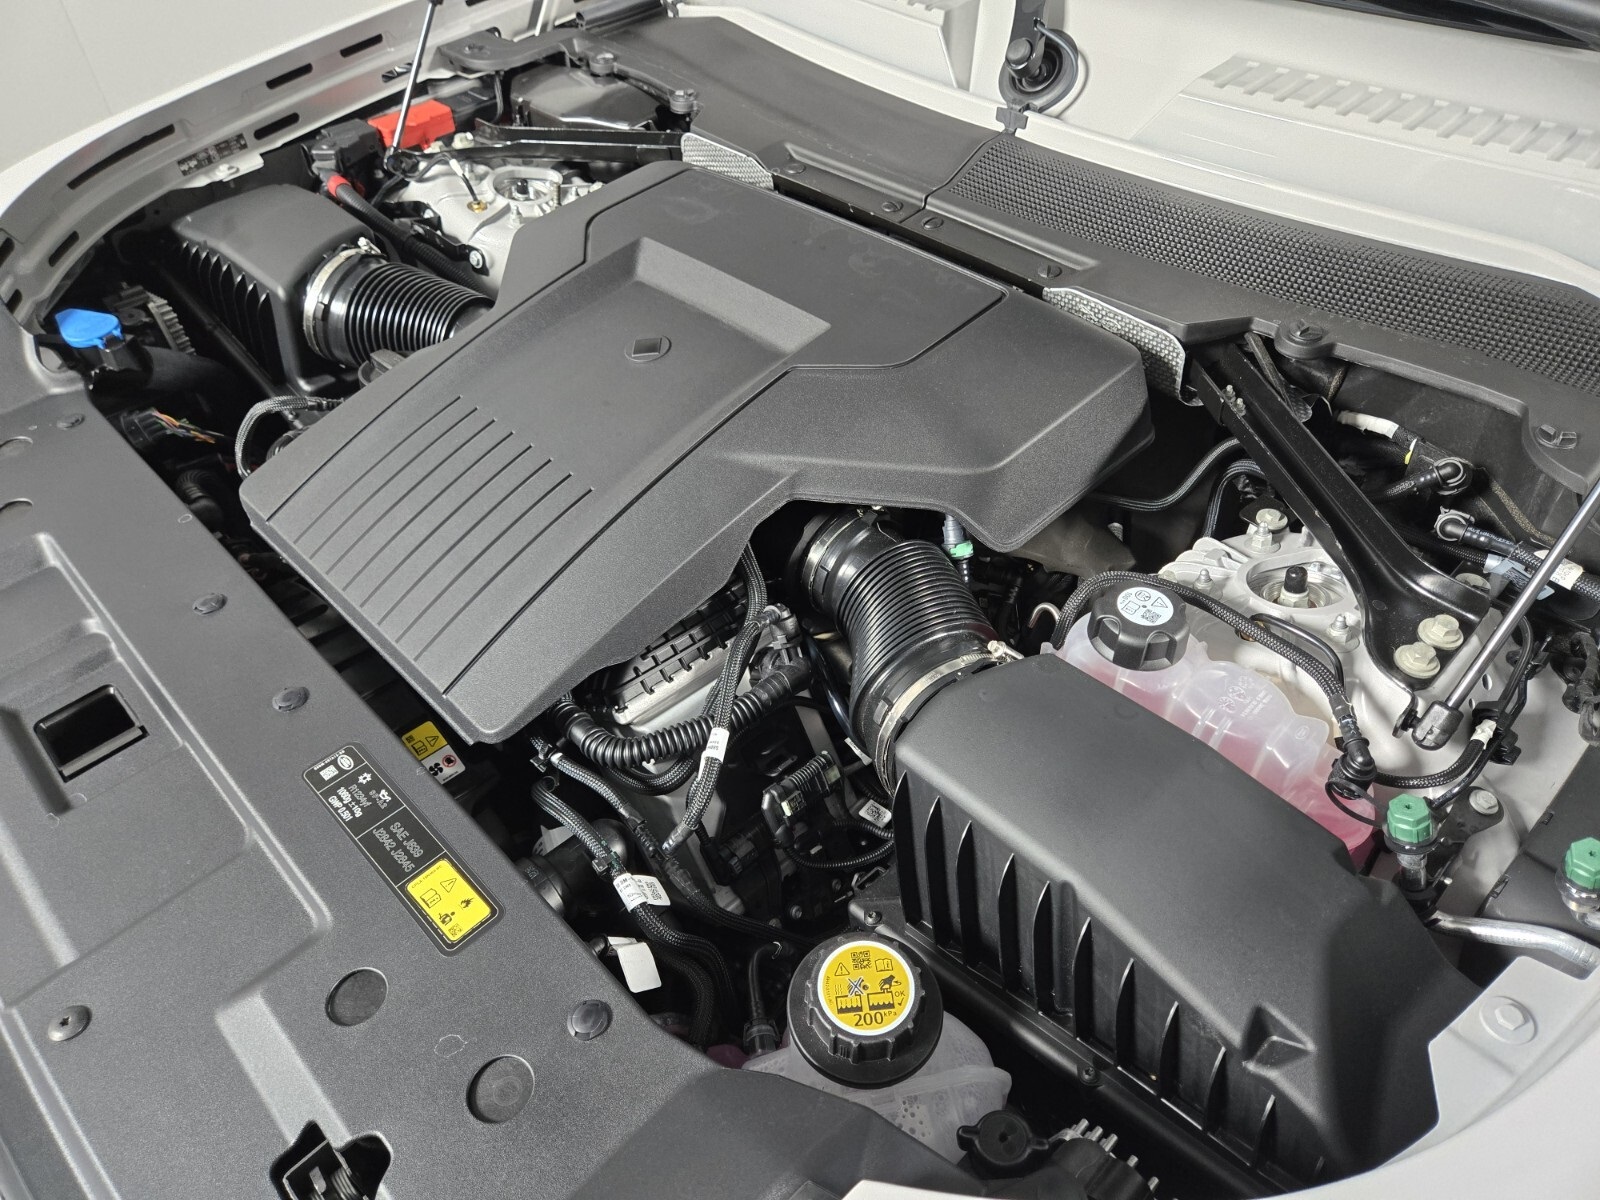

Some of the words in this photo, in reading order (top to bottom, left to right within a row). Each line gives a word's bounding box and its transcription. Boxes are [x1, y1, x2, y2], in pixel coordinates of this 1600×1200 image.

[348, 784, 372, 808] R1234yf
[328, 795, 343, 808] GWP
[337, 806, 353, 822] 0.501
[372, 827, 397, 851] J2842
[390, 821, 410, 841] SAE
[853, 1011, 884, 1027] 200
